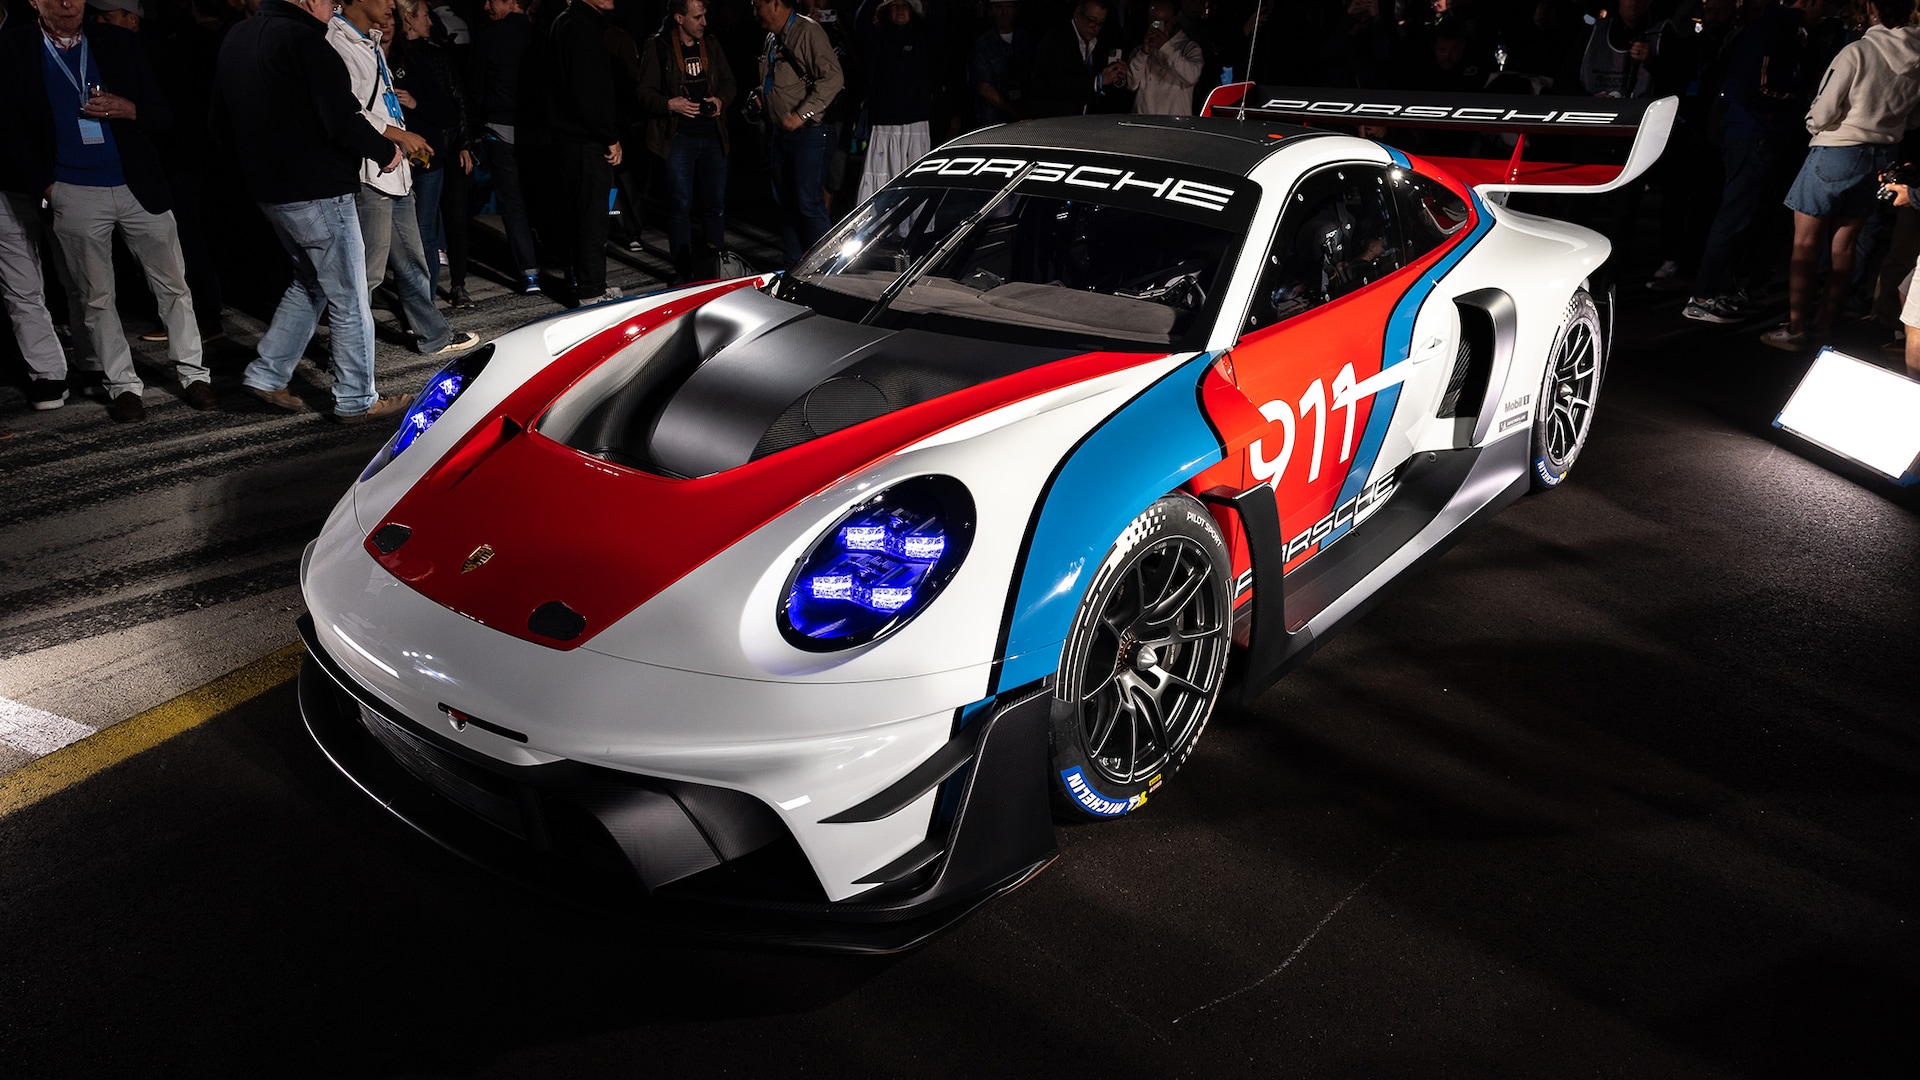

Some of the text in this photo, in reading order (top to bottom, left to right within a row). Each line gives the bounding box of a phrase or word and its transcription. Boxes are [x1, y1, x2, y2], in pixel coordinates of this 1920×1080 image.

[1261, 99, 1619, 123] PORSCHE
[905, 157, 1235, 212] PORSCHE
[1504, 397, 1522, 413] Mobil
[1249, 361, 1357, 492] 911
[1186, 511, 1222, 547] PILOT SPORT
[1234, 468, 1396, 599] PRSCHE
[1066, 772, 1127, 814] MICHELIN
